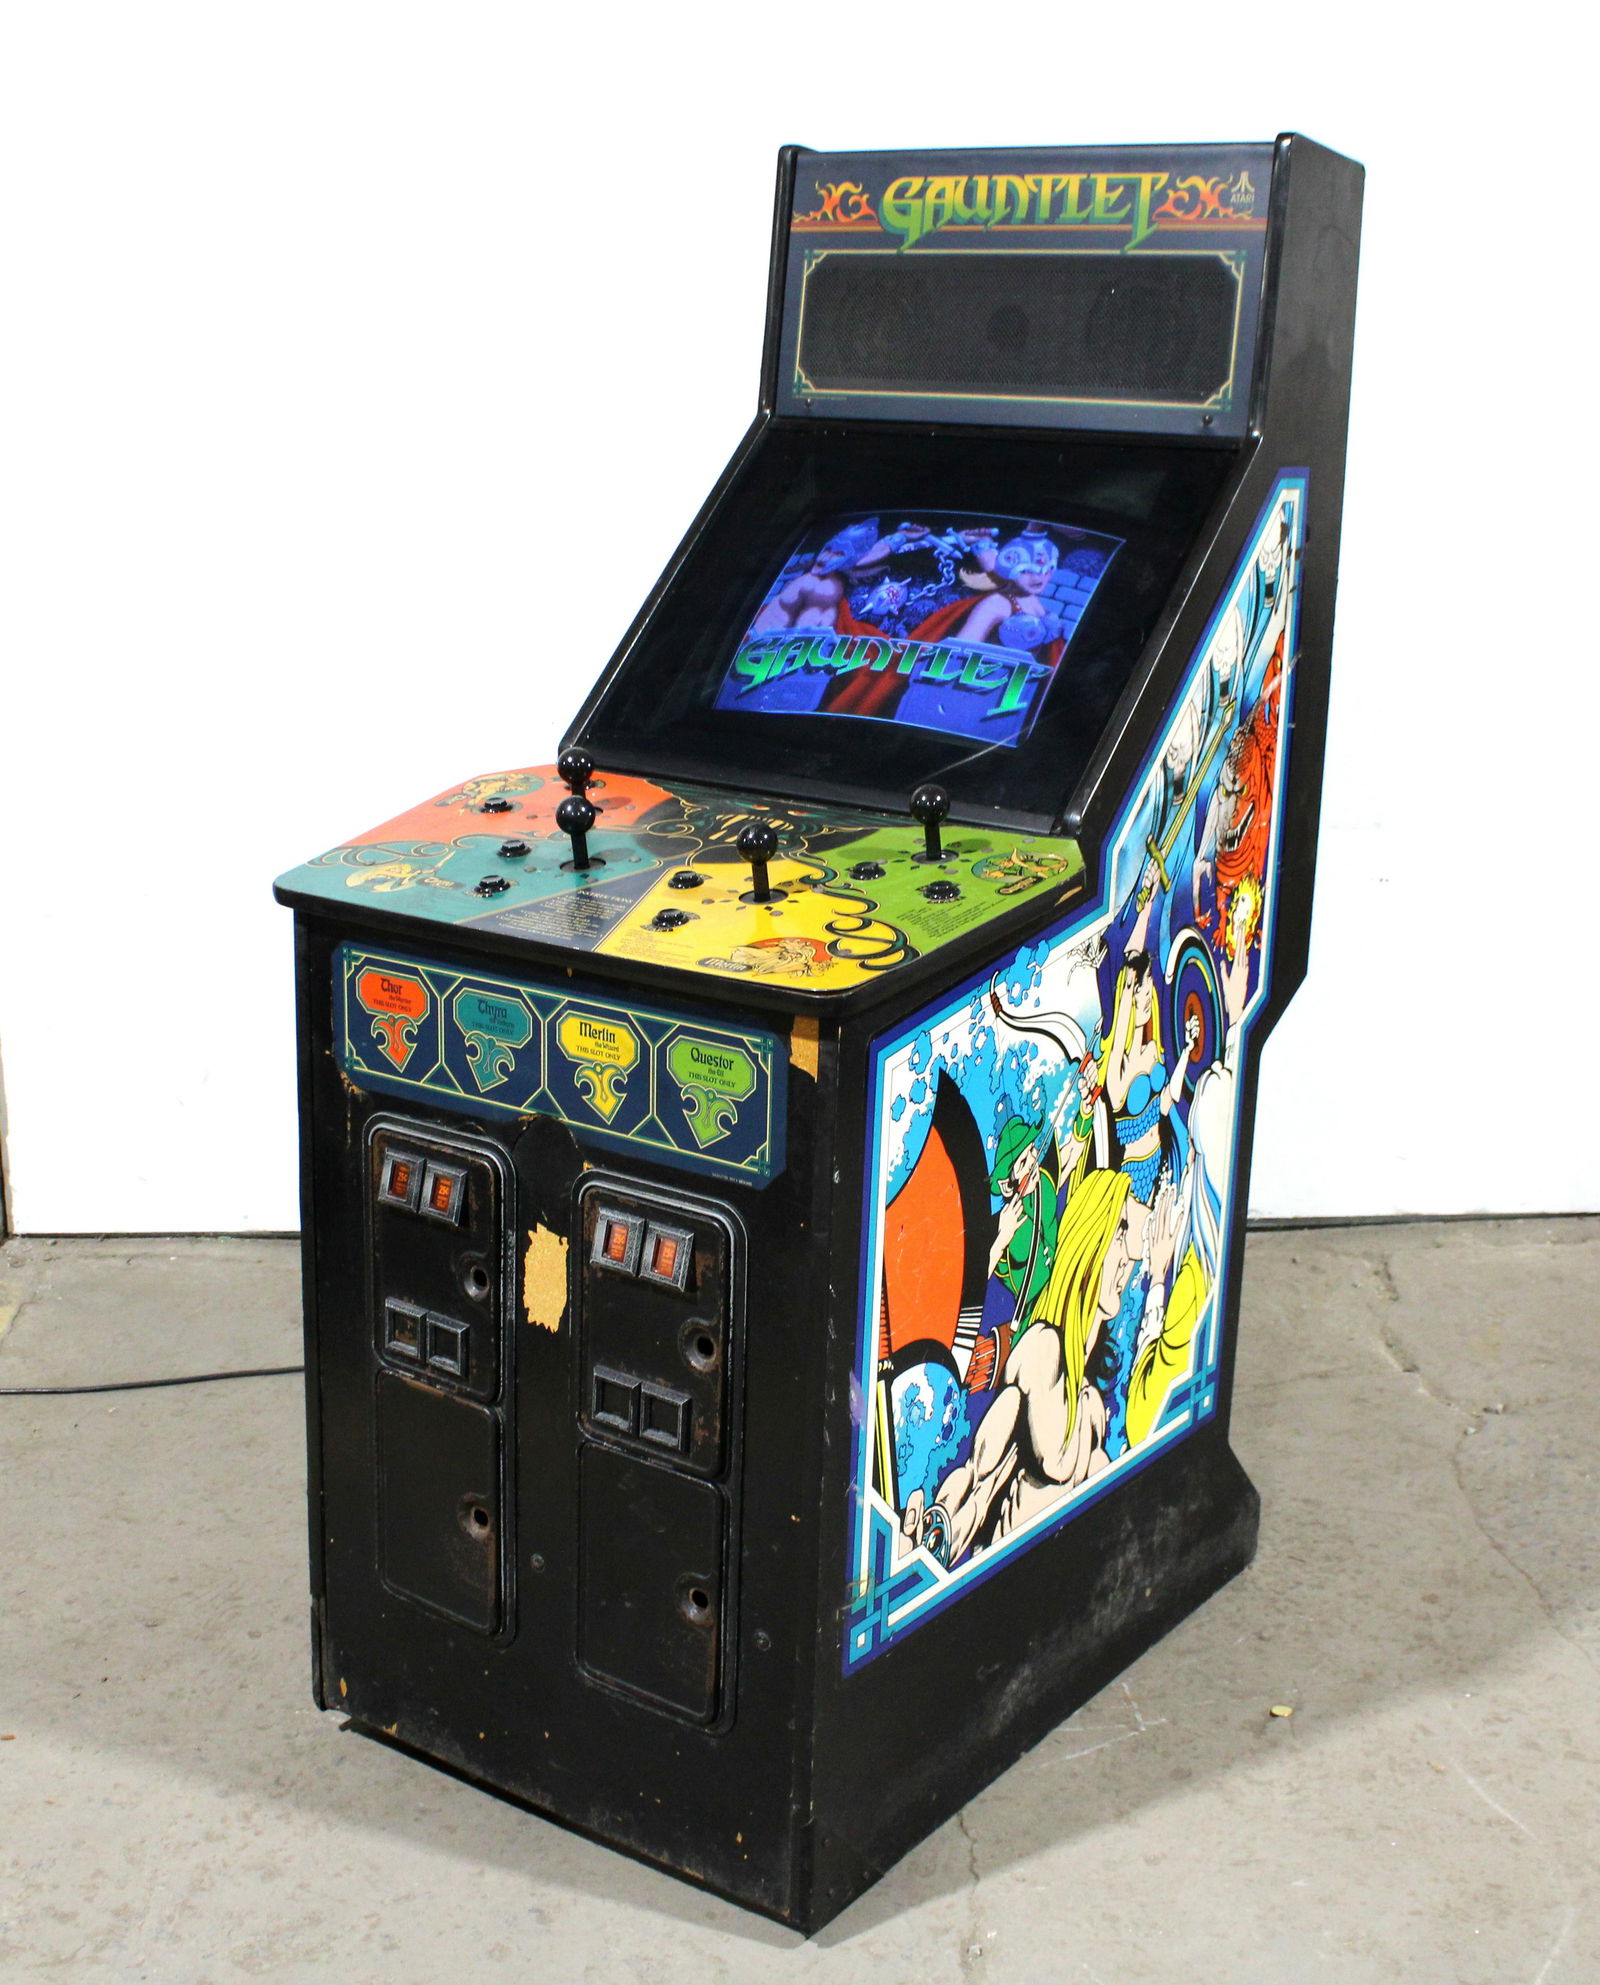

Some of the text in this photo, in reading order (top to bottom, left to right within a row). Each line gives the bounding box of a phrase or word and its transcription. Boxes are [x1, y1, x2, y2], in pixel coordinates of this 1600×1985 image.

[1231, 193, 1255, 203] ATARI
[880, 172, 1170, 254] GAUNTLET
[734, 633, 1055, 717] GAUNTLET
[380, 977, 403, 995] Thor
[477, 999, 508, 1019] Thyra
[579, 1021, 616, 1043] Merlin
[576, 1045, 621, 1060] THIS SLOT ONLY
[690, 1047, 735, 1071] Questor
[688, 1071, 736, 1088] THIS SLOT ONLY
